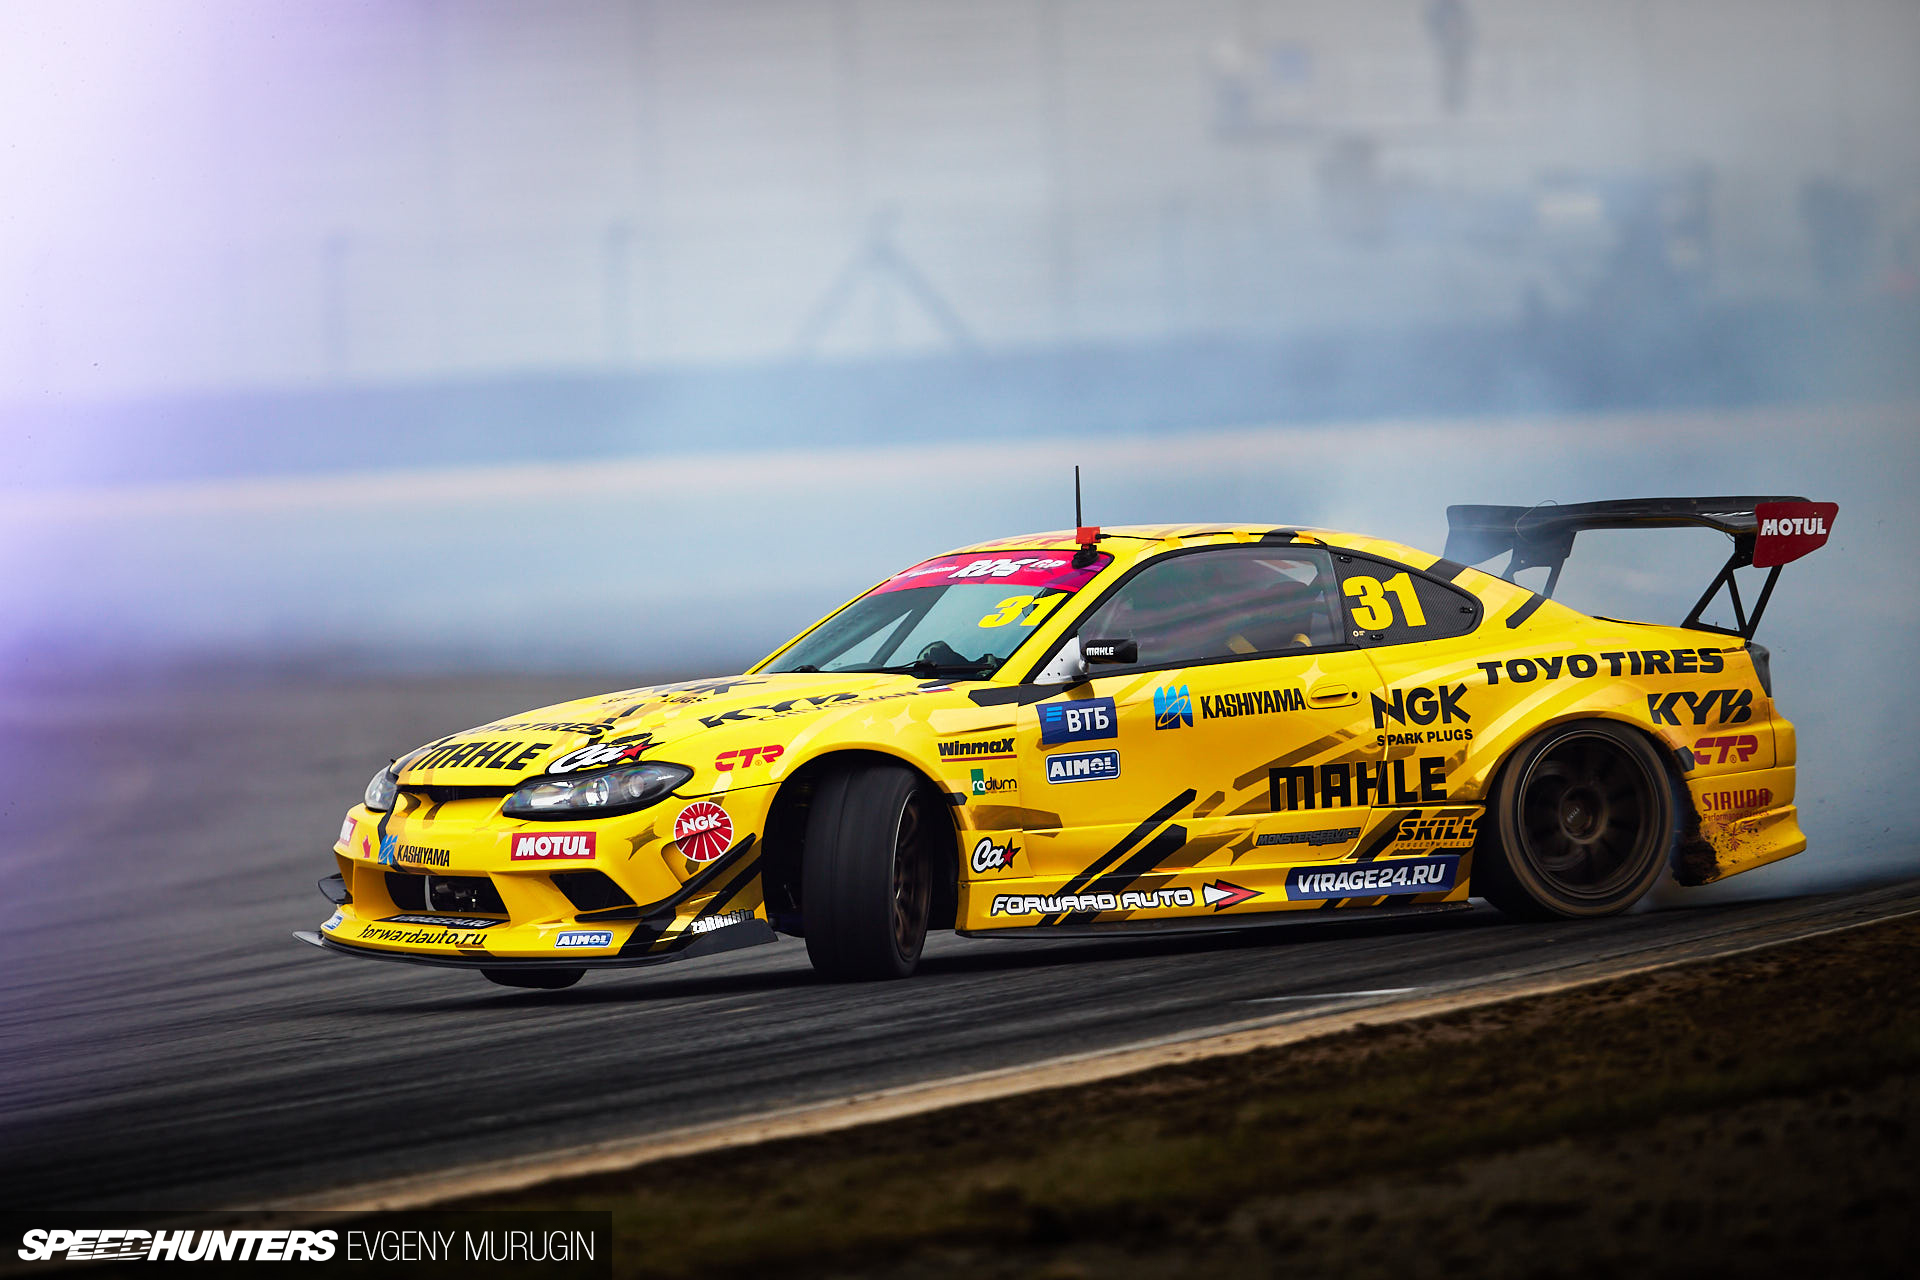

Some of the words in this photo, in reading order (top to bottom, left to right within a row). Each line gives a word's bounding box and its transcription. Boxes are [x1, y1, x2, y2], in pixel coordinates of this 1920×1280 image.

[1760, 517, 1827, 536] MOTUL
[978, 592, 1068, 628] 31
[1342, 572, 1427, 631] 31
[1086, 646, 1115, 657] MAHLE
[1477, 653, 1598, 686] TOYO
[1600, 647, 1725, 677] TIRES
[1200, 687, 1306, 719] KASHIYAMA
[1370, 682, 1472, 729] NGK
[1646, 688, 1754, 726] KYB
[1065, 706, 1110, 733] ВТБ
[1376, 731, 1424, 747] SPARK
[1427, 728, 1474, 743] PLUGS
[1693, 734, 1759, 766] CTR
[408, 741, 554, 772] MAHLE
[714, 744, 785, 772] CTR
[1049, 756, 1117, 778] AIMOL
[972, 776, 1018, 791] radium
[1268, 756, 1448, 812] MAHLE
[680, 811, 723, 835] NGK
[397, 844, 451, 867] KASHIYAMA
[515, 835, 591, 857] MOTUL
[1297, 863, 1446, 895] VIRAGE24.RU
[991, 894, 1117, 916] FORWARD
[1122, 887, 1195, 911] AUTO
[358, 924, 488, 945] forwardauto.ru
[556, 934, 610, 946] AIMOL
